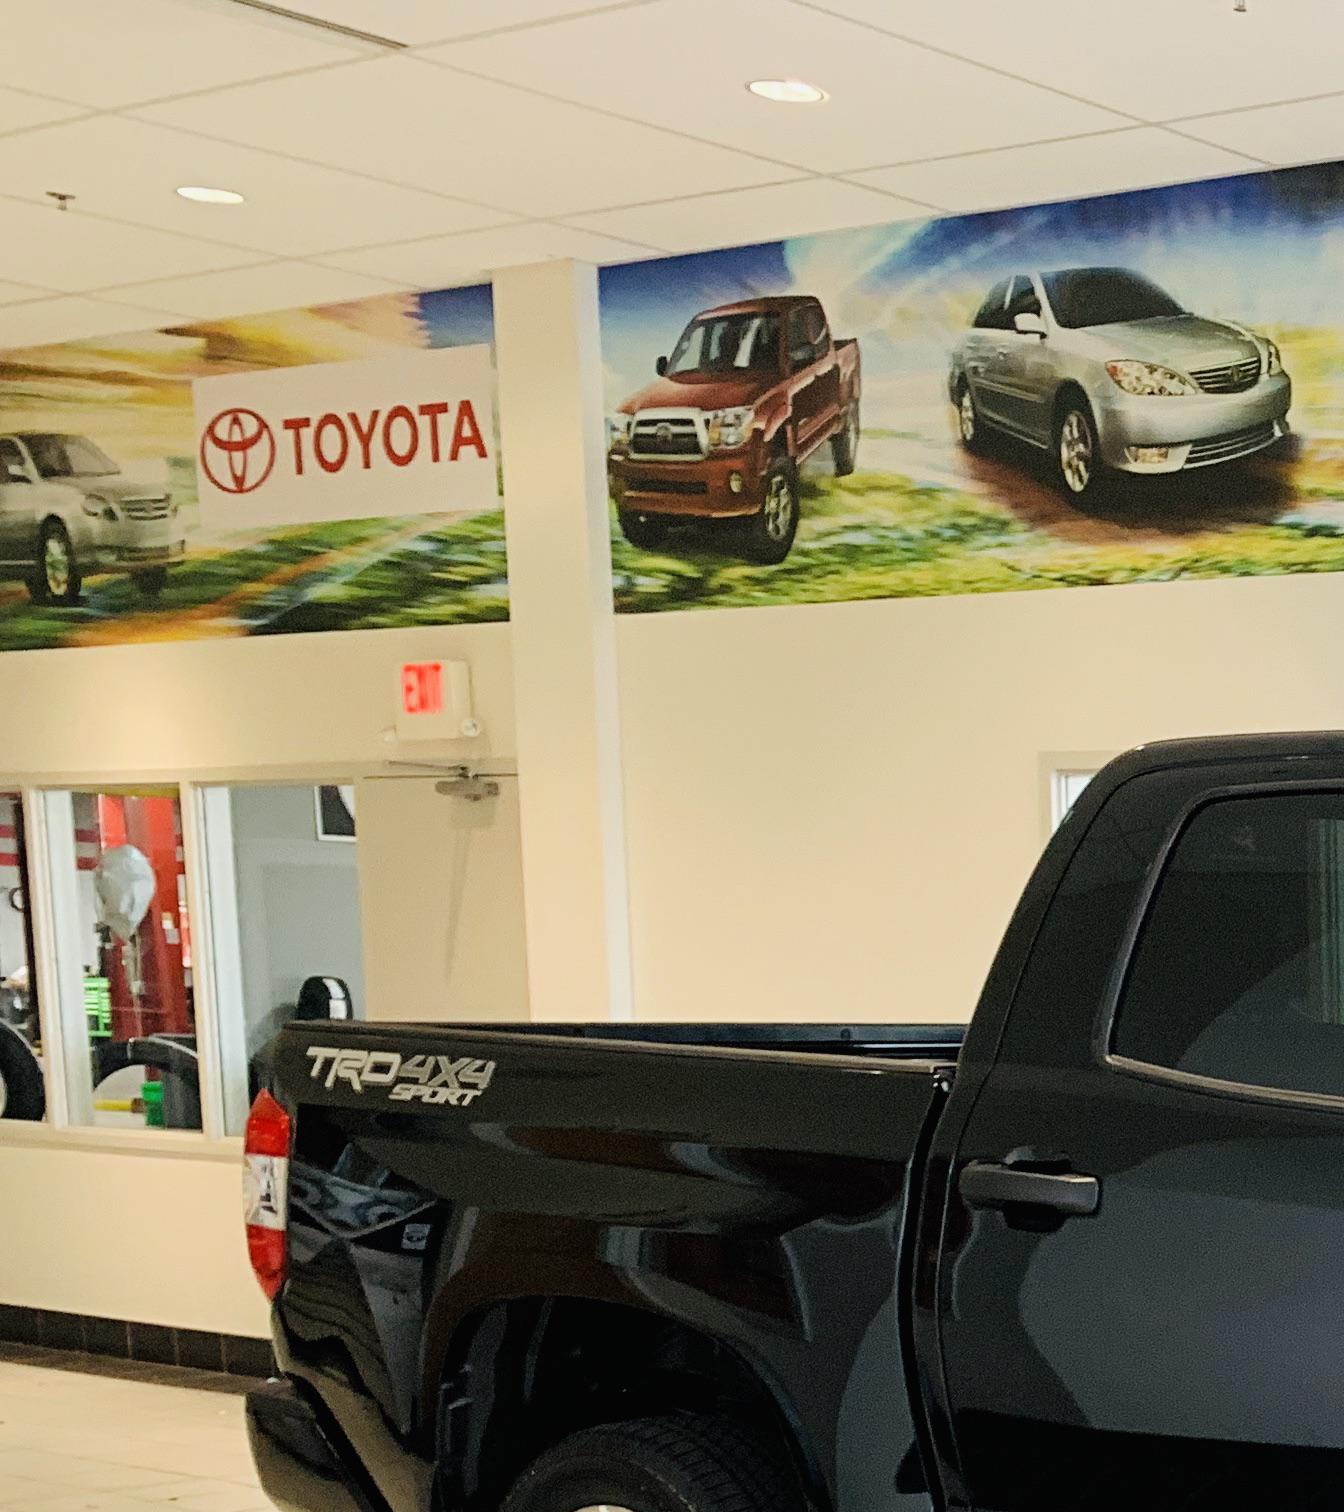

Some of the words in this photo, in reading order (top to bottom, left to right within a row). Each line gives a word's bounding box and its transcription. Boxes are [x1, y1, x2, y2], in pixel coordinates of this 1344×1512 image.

[283, 400, 486, 474] TOYOTA
[306, 1046, 402, 1094] TRD
[388, 1083, 483, 1107] SPORT
